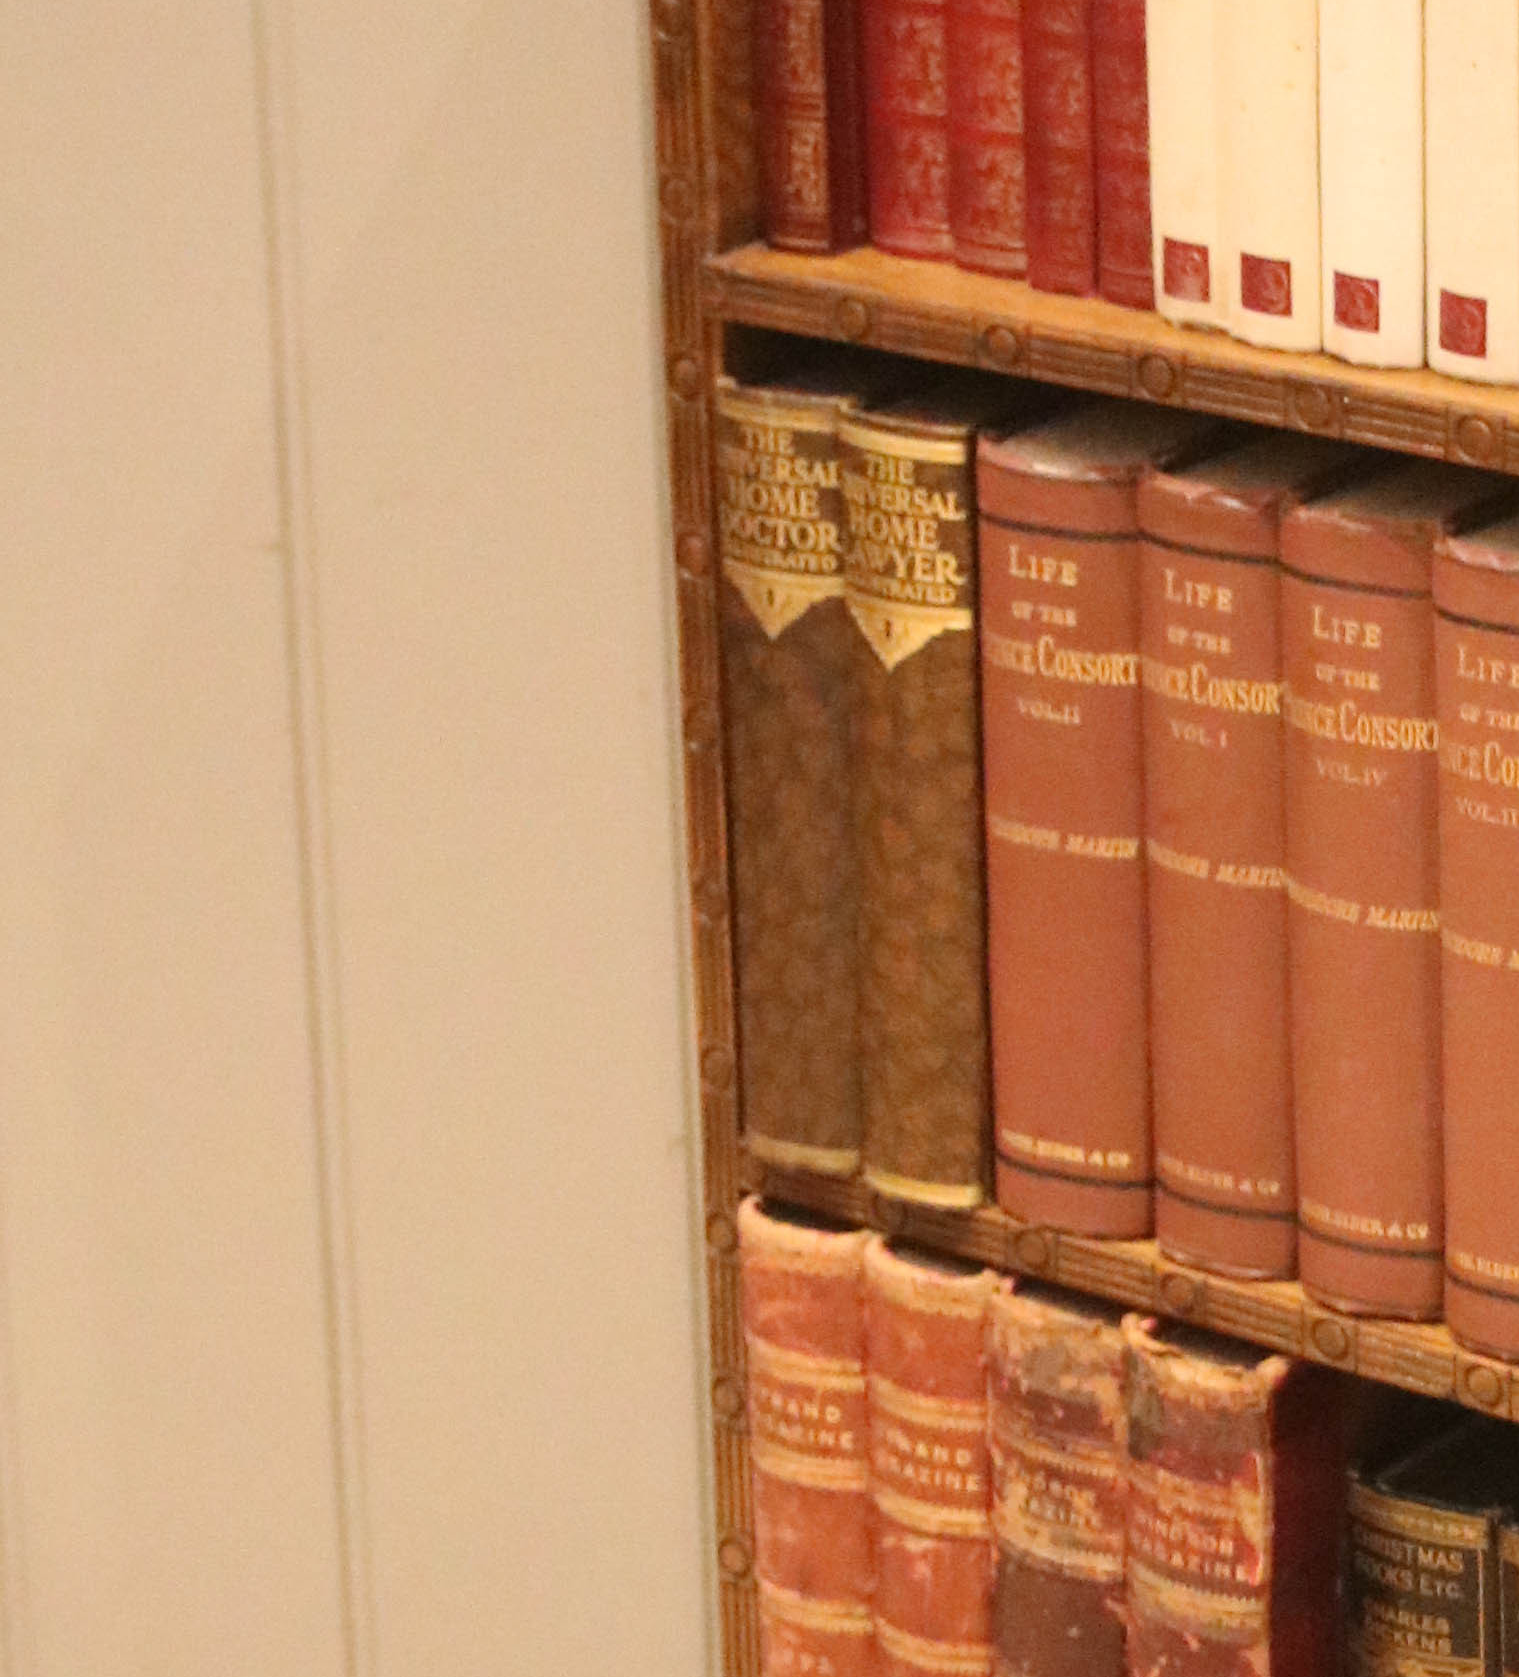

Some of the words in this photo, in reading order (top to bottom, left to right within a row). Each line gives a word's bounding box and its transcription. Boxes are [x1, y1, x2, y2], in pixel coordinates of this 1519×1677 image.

[746, 427, 794, 456] THE
[866, 452, 915, 485] THE
[849, 502, 940, 550] HOME
[1009, 545, 1078, 586] LIFE
[1164, 569, 1232, 613] LIFE
[1012, 601, 1033, 622] OF
[1039, 604, 1077, 628] THE
[1312, 604, 1382, 649] LIFE
[1168, 626, 1188, 647] OF
[1194, 631, 1232, 655] THE
[1037, 634, 1139, 686] CONSORT
[1316, 663, 1337, 683] OF
[1344, 668, 1381, 692] THE
[1190, 662, 1283, 716] CONSOR
[1460, 703, 1481, 723] OF
[1360, 1528, 1464, 1574] RISTMAS
[1364, 1598, 1451, 1634] HARLES
